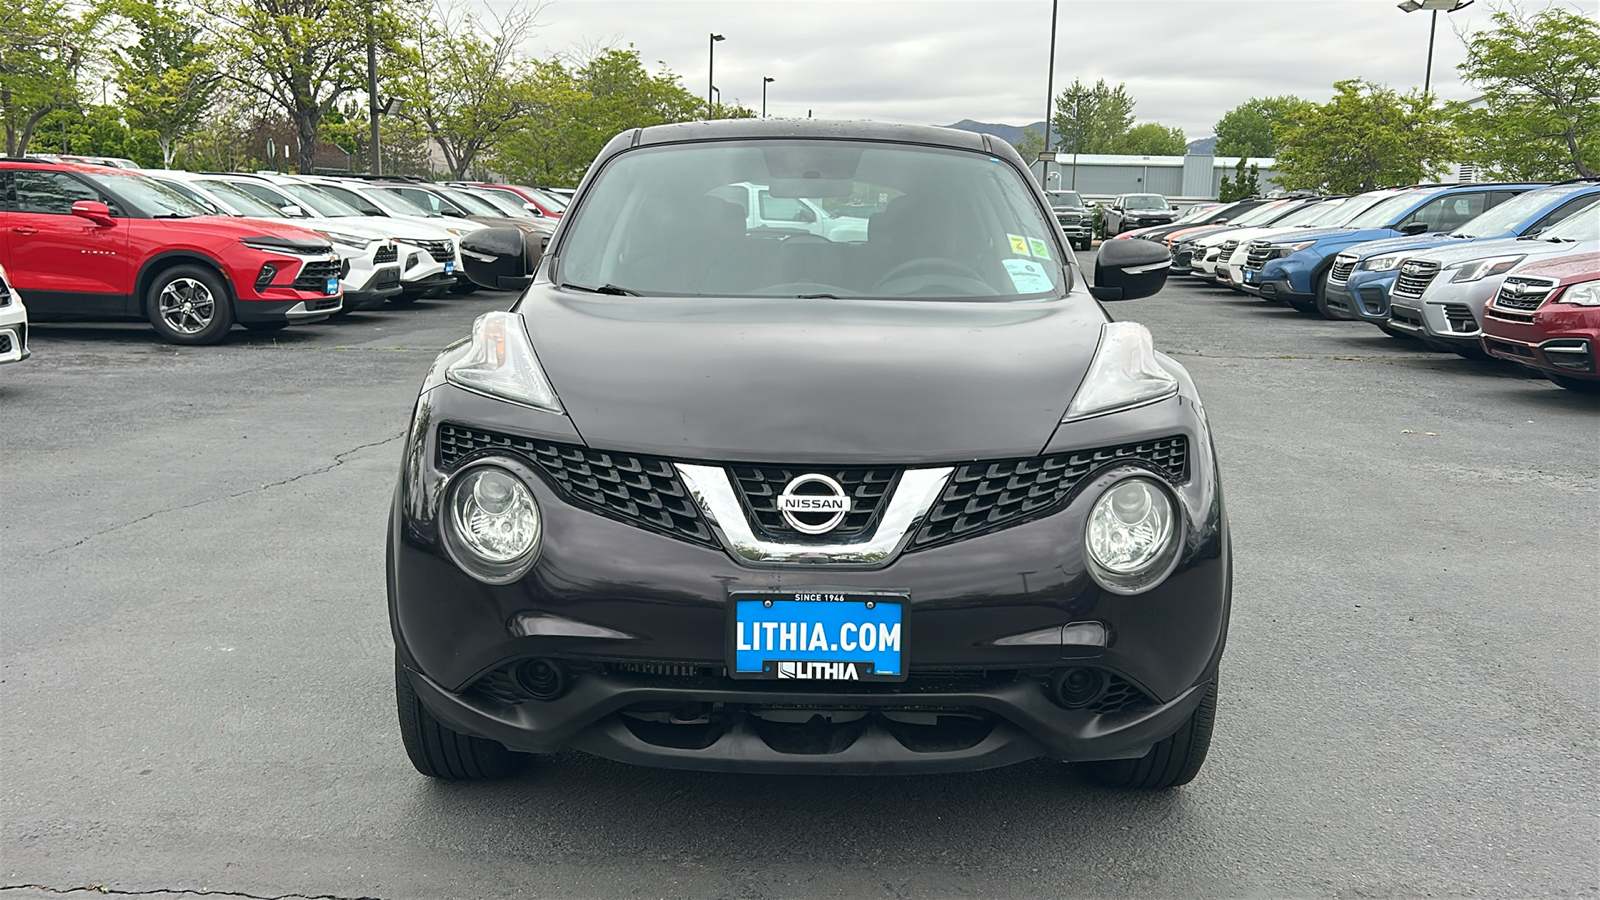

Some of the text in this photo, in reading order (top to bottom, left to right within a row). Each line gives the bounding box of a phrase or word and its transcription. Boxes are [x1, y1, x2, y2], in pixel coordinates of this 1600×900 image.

[785, 499, 843, 508] NISSAN
[824, 594, 845, 602] 1946
[736, 622, 901, 651] LITHIA.COM
[796, 662, 859, 680] LITHIA
